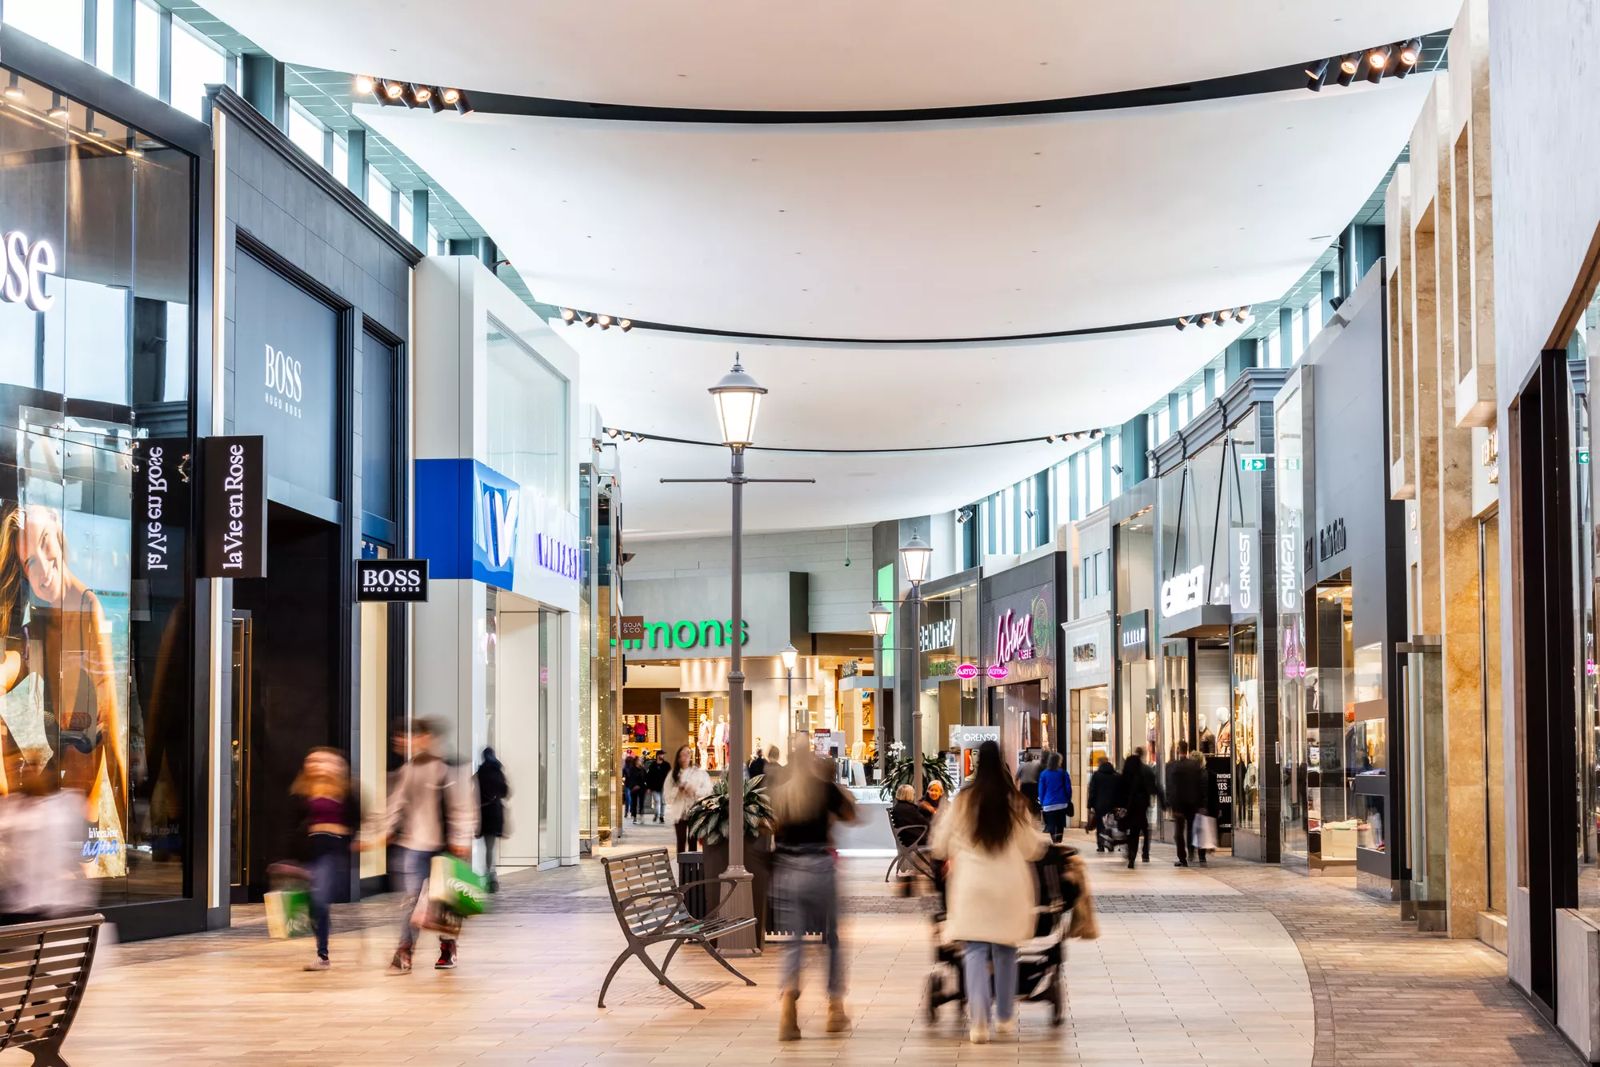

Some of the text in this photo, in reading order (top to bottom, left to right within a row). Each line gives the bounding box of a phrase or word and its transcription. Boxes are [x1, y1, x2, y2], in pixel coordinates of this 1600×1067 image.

[0, 232, 56, 311] se
[265, 344, 302, 402] BOSS
[225, 444, 244, 491] Rose
[363, 569, 421, 586] BOSS
[1239, 532, 1250, 609] ERNEST
[610, 617, 749, 650] mons
